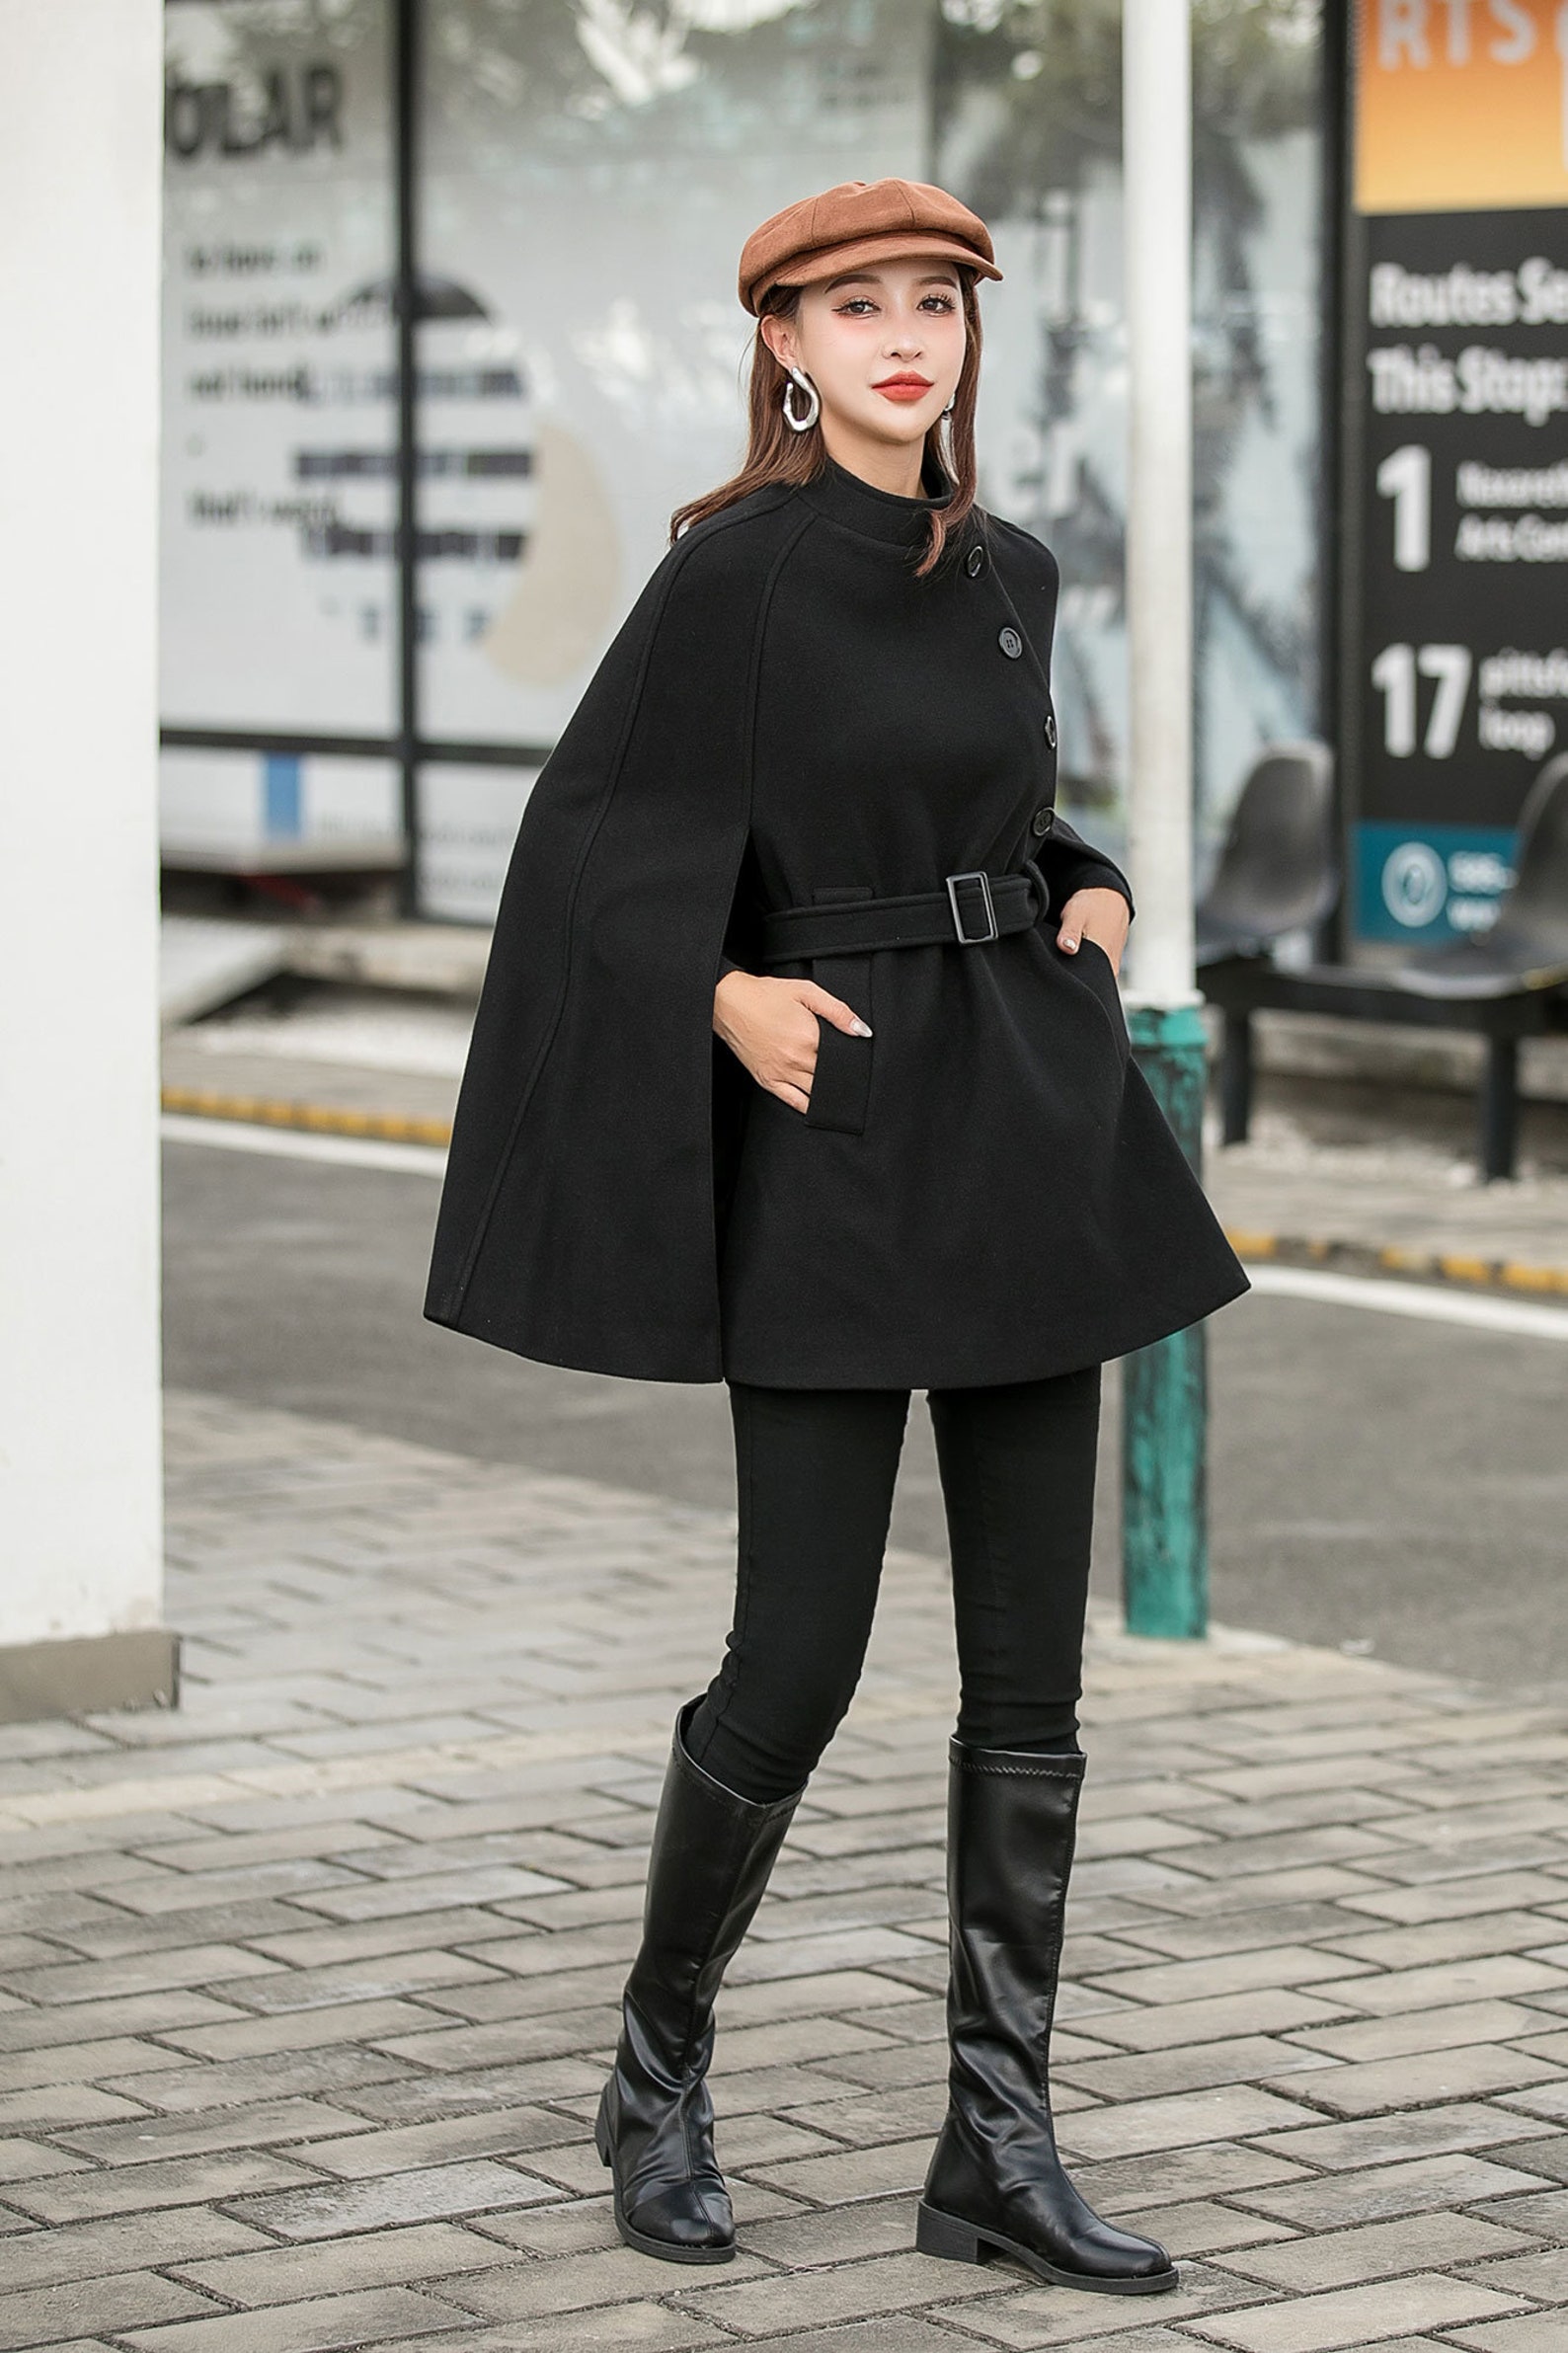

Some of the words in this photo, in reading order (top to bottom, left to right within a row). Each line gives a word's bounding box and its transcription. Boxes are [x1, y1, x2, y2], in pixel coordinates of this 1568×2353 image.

[1370, 262, 1519, 328] Routes
[1366, 343, 1457, 414] This
[1376, 444, 1431, 573] 1
[1372, 643, 1472, 759] 17
